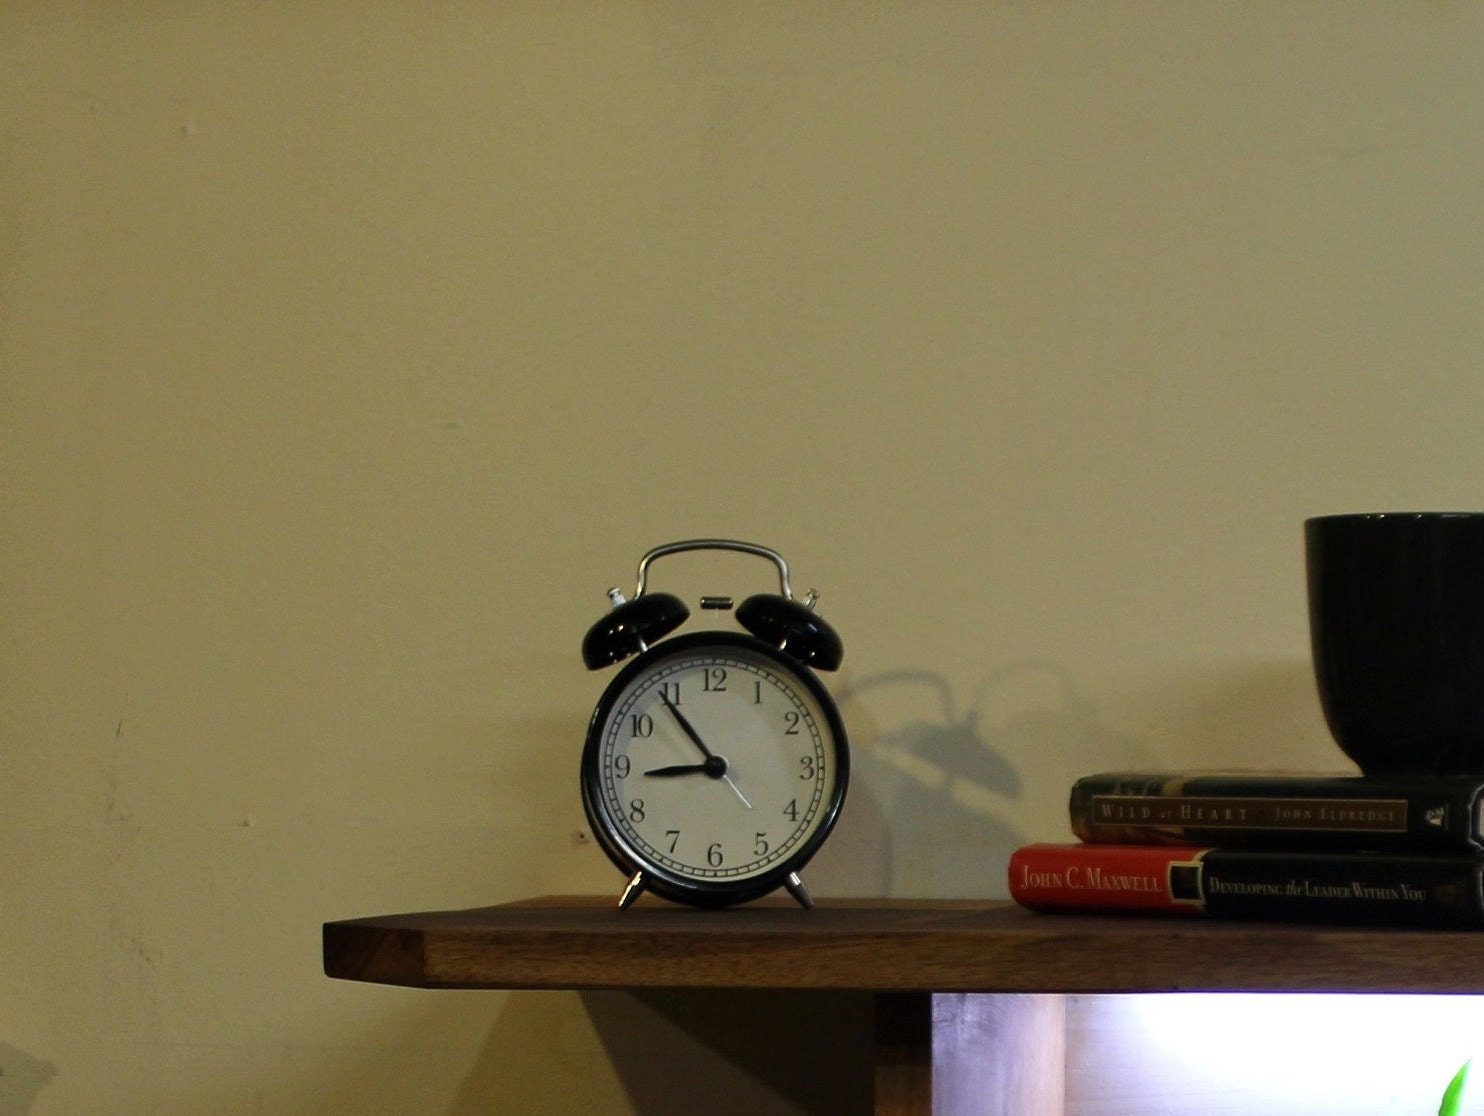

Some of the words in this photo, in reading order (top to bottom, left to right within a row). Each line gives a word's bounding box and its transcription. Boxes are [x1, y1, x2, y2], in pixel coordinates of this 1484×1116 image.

[702, 668, 727, 692] 12
[661, 682, 682, 706] 11
[753, 681, 762, 704] 1
[631, 714, 653, 738] 10
[784, 712, 800, 735] 2
[615, 755, 631, 779] 9
[799, 756, 815, 780] 3
[630, 799, 645, 823] 8
[783, 799, 800, 822] 4
[665, 830, 680, 854] 7
[753, 832, 769, 856] 5
[707, 843, 724, 867] 6
[1021, 865, 1064, 889] JOHN
[1067, 867, 1084, 889] C.
[1086, 867, 1162, 892] MAXWELL
[1209, 877, 1284, 895] DEVELOPING
[1286, 880, 1302, 896] the
[1352, 882, 1399, 900] WITHIN
[1400, 884, 1426, 901] YOU
